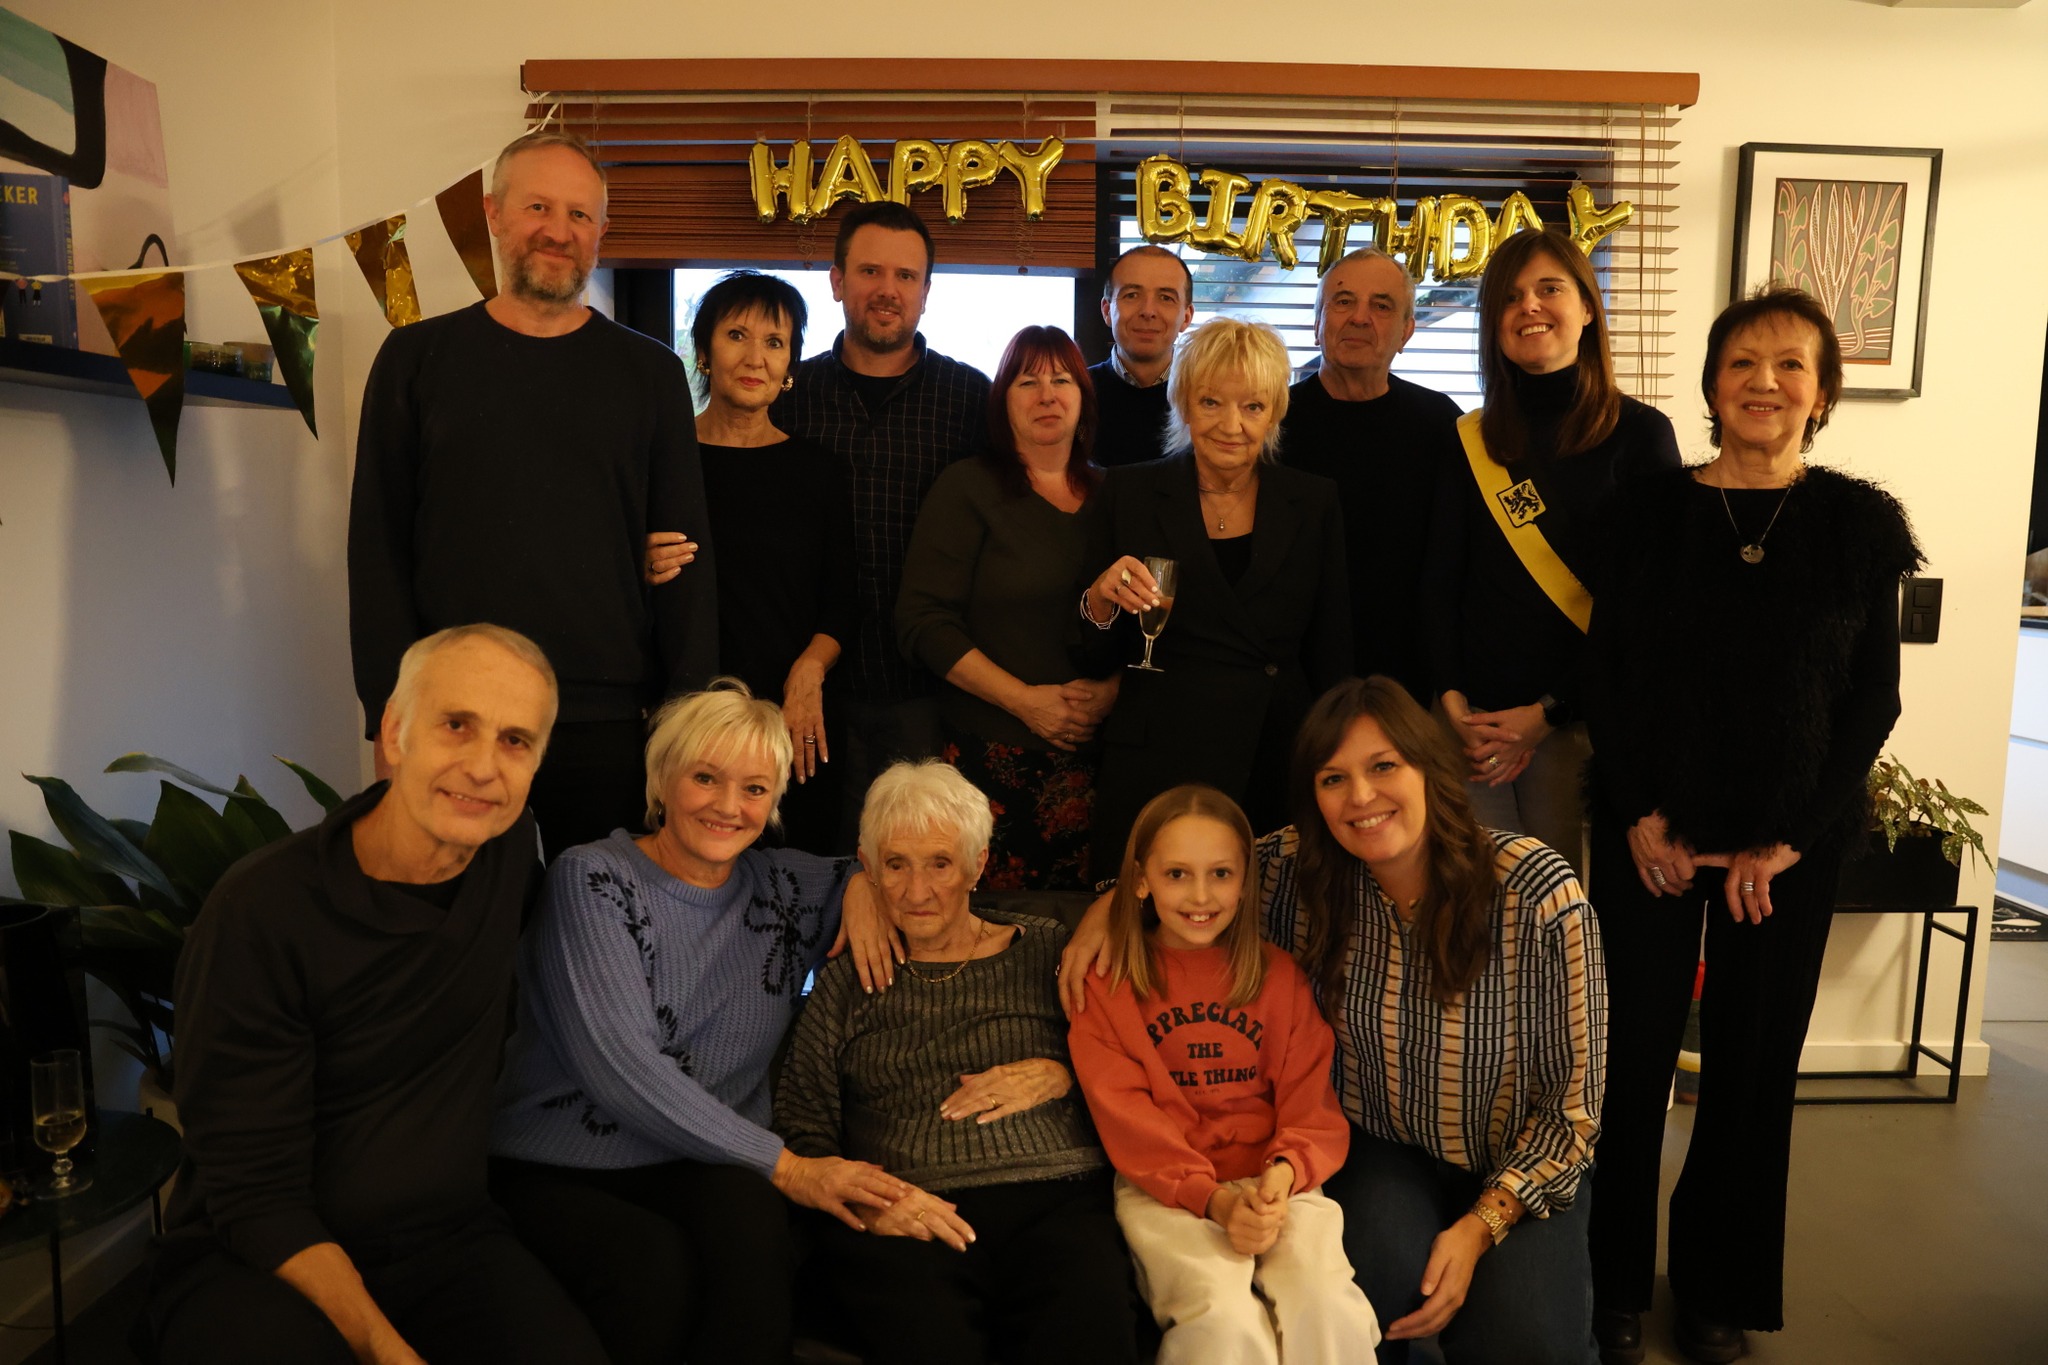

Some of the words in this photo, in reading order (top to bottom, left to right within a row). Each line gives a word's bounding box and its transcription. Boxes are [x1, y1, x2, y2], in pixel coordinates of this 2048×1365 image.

[0, 185, 38, 206] KER
[750, 134, 1064, 225] HAPPY
[1136, 155, 1634, 283] BIRTHDAY
[1147, 1002, 1264, 1051] PPRECIAT
[1187, 1043, 1223, 1059] THE
[1169, 1071, 1198, 1086] TLE
